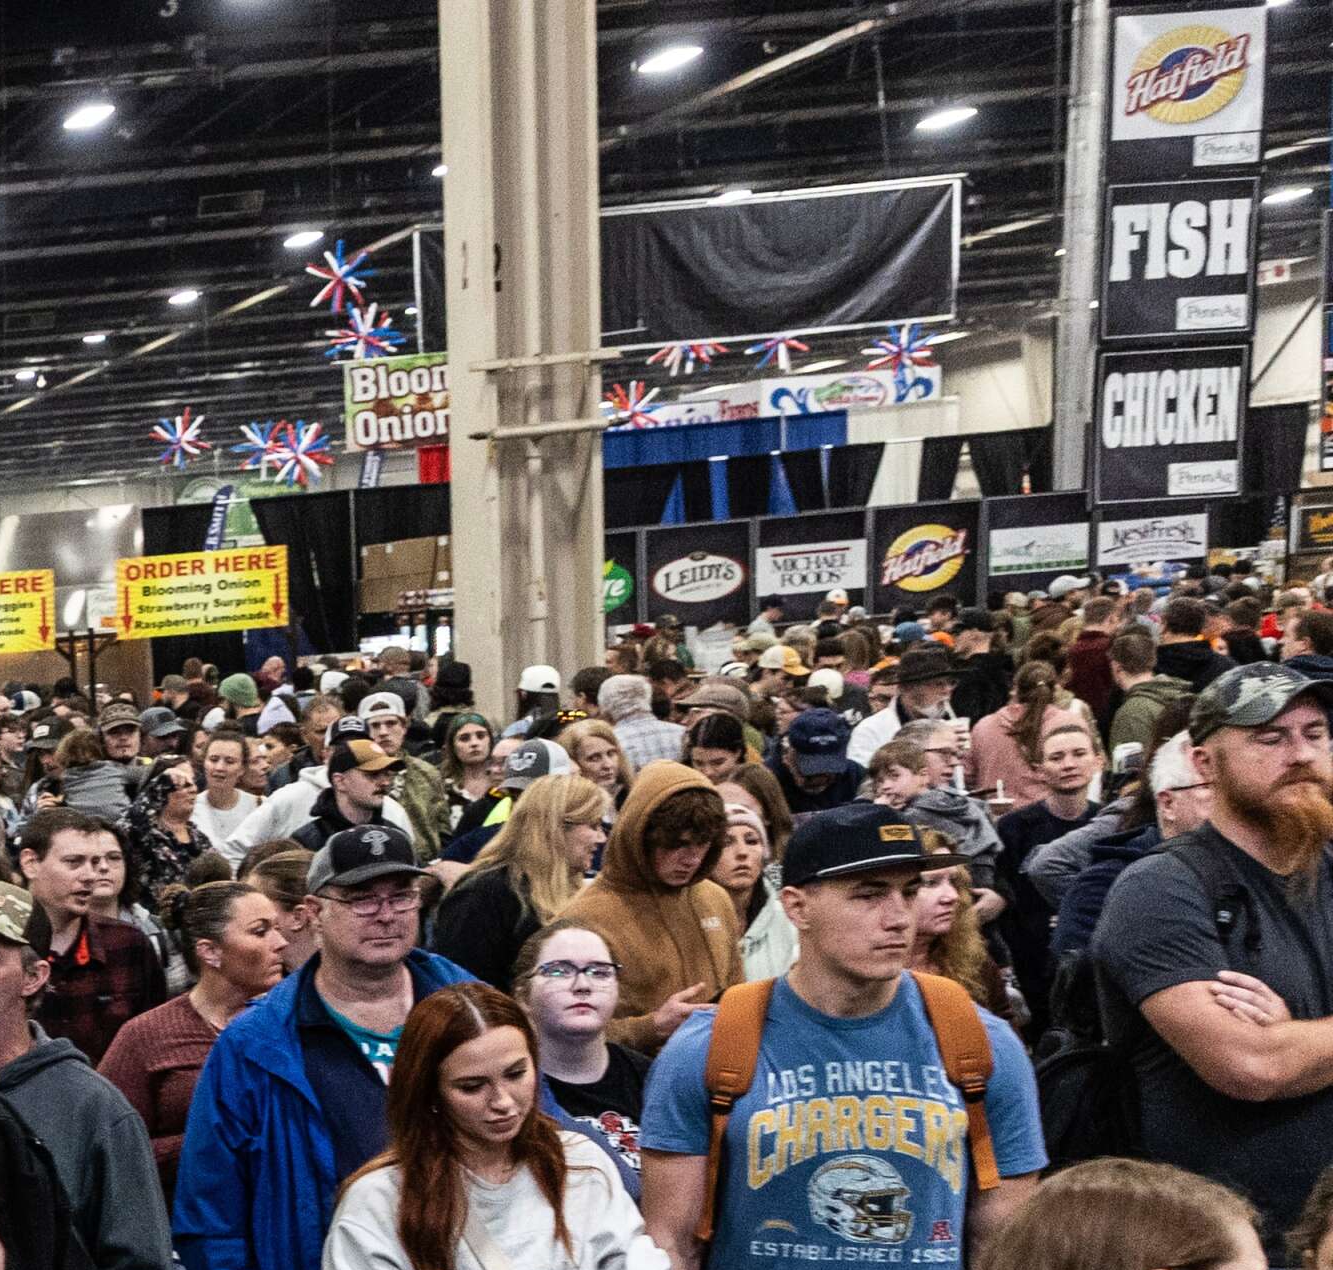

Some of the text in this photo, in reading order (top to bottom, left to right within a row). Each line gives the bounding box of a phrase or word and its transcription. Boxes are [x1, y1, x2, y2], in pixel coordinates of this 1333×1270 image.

[1126, 33, 1250, 115] Hatfield
[1109, 199, 1251, 281] FISH
[1102, 366, 1240, 449] CHICKEN
[126, 553, 278, 581] ORDER HERE
[772, 554, 851, 573] MICHAEL
[882, 530, 968, 586] Hatfield
[142, 579, 261, 597] Blooming Onion
[664, 561, 734, 593] LEIDY'S
[781, 571, 841, 588] FOODS
[137, 596, 266, 614] Strawberry Surprise
[134, 611, 270, 630] Raspberry Lemonade
[767, 1064, 816, 1105] LOS
[747, 1095, 969, 1194] CHARGERS
[750, 1241, 903, 1262] ESTABLISHED
